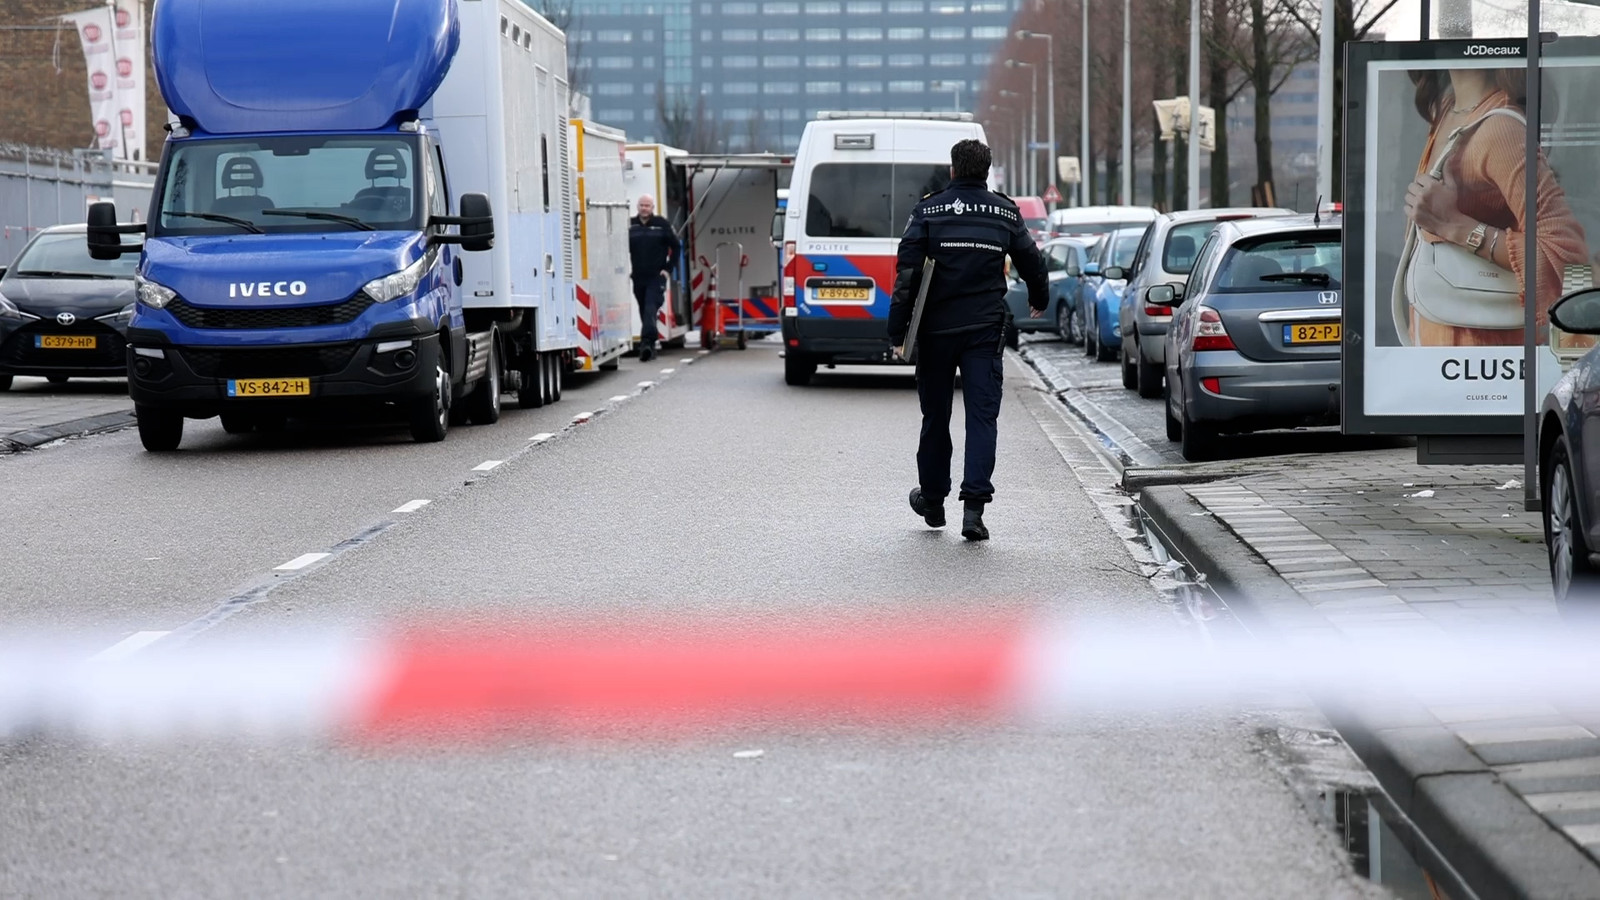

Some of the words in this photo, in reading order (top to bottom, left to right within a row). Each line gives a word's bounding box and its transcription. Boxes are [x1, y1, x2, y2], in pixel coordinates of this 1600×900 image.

[1463, 45, 1520, 55] JCDecaux
[710, 226, 755, 234] POLITIE
[229, 280, 307, 297] IVECO
[820, 289, 865, 298] V-896-VS
[1298, 326, 1340, 340] 82-PJ
[44, 336, 93, 347] G-379-HP
[239, 381, 304, 394] VS-842-H
